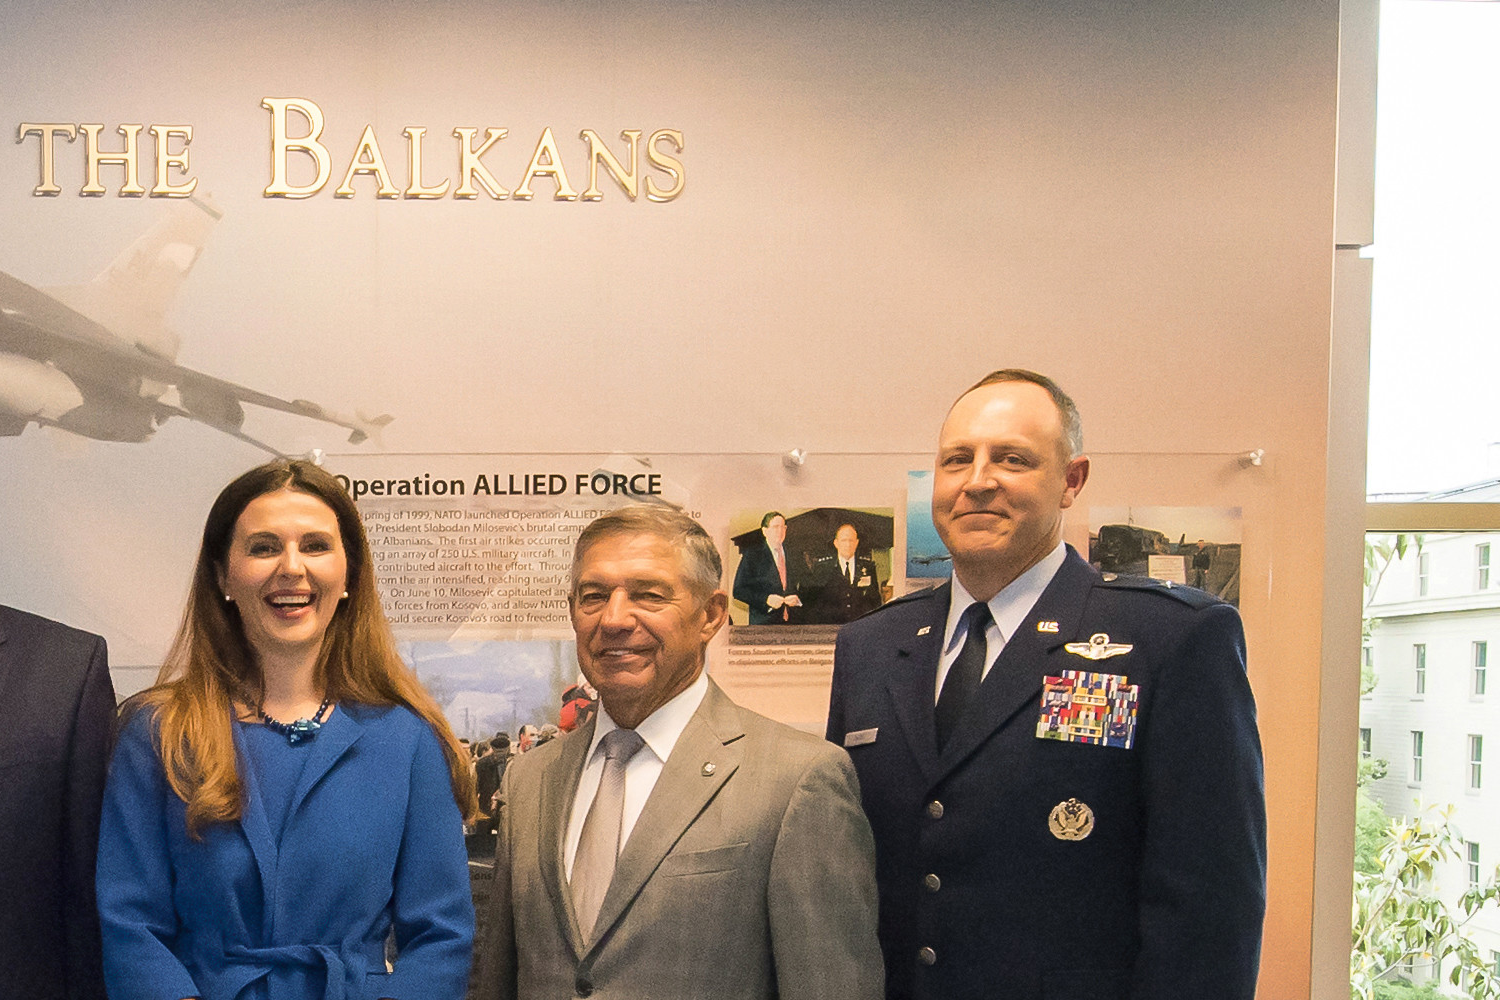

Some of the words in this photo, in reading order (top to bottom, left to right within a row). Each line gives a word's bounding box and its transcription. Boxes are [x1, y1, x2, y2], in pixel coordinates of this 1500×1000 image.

[18, 119, 199, 199] THE
[261, 96, 687, 203] BALKANS
[473, 474, 567, 496] ALLIED
[575, 473, 662, 495] FORCE
[434, 510, 461, 519] NATO
[464, 510, 509, 519] launched
[511, 509, 561, 521] Operation
[563, 509, 598, 519] ALLIED
[375, 523, 421, 533] President
[424, 523, 470, 533] Slobodan
[472, 523, 524, 532] Milosevic's
[527, 523, 555, 532] brutal
[383, 536, 433, 546] Albanians.
[439, 536, 457, 545] The
[458, 536, 477, 545] first
[495, 536, 524, 545] strikes
[527, 536, 570, 545] occurred
[402, 552, 426, 561] array
[441, 549, 459, 558] 250
[482, 549, 519, 560] military
[377, 562, 435, 572] contributed
[437, 562, 471, 571] aircraft
[486, 562, 502, 571] the
[400, 575, 416, 584] the
[432, 575, 486, 586] intensified,
[488, 575, 530, 586] reaching
[533, 575, 562, 586] nearly
[408, 588, 431, 598] June
[449, 587, 494, 597] Milosevic
[497, 587, 552, 599] capitulated
[394, 601, 423, 610] forces
[425, 601, 449, 610] from
[451, 600, 489, 611] Kosovo,
[491, 600, 510, 609] and
[512, 600, 538, 609] allow
[540, 599, 568, 609] NATO
[446, 613, 487, 623] Kosovo's
[489, 613, 512, 622] road
[526, 612, 568, 622] freedom
